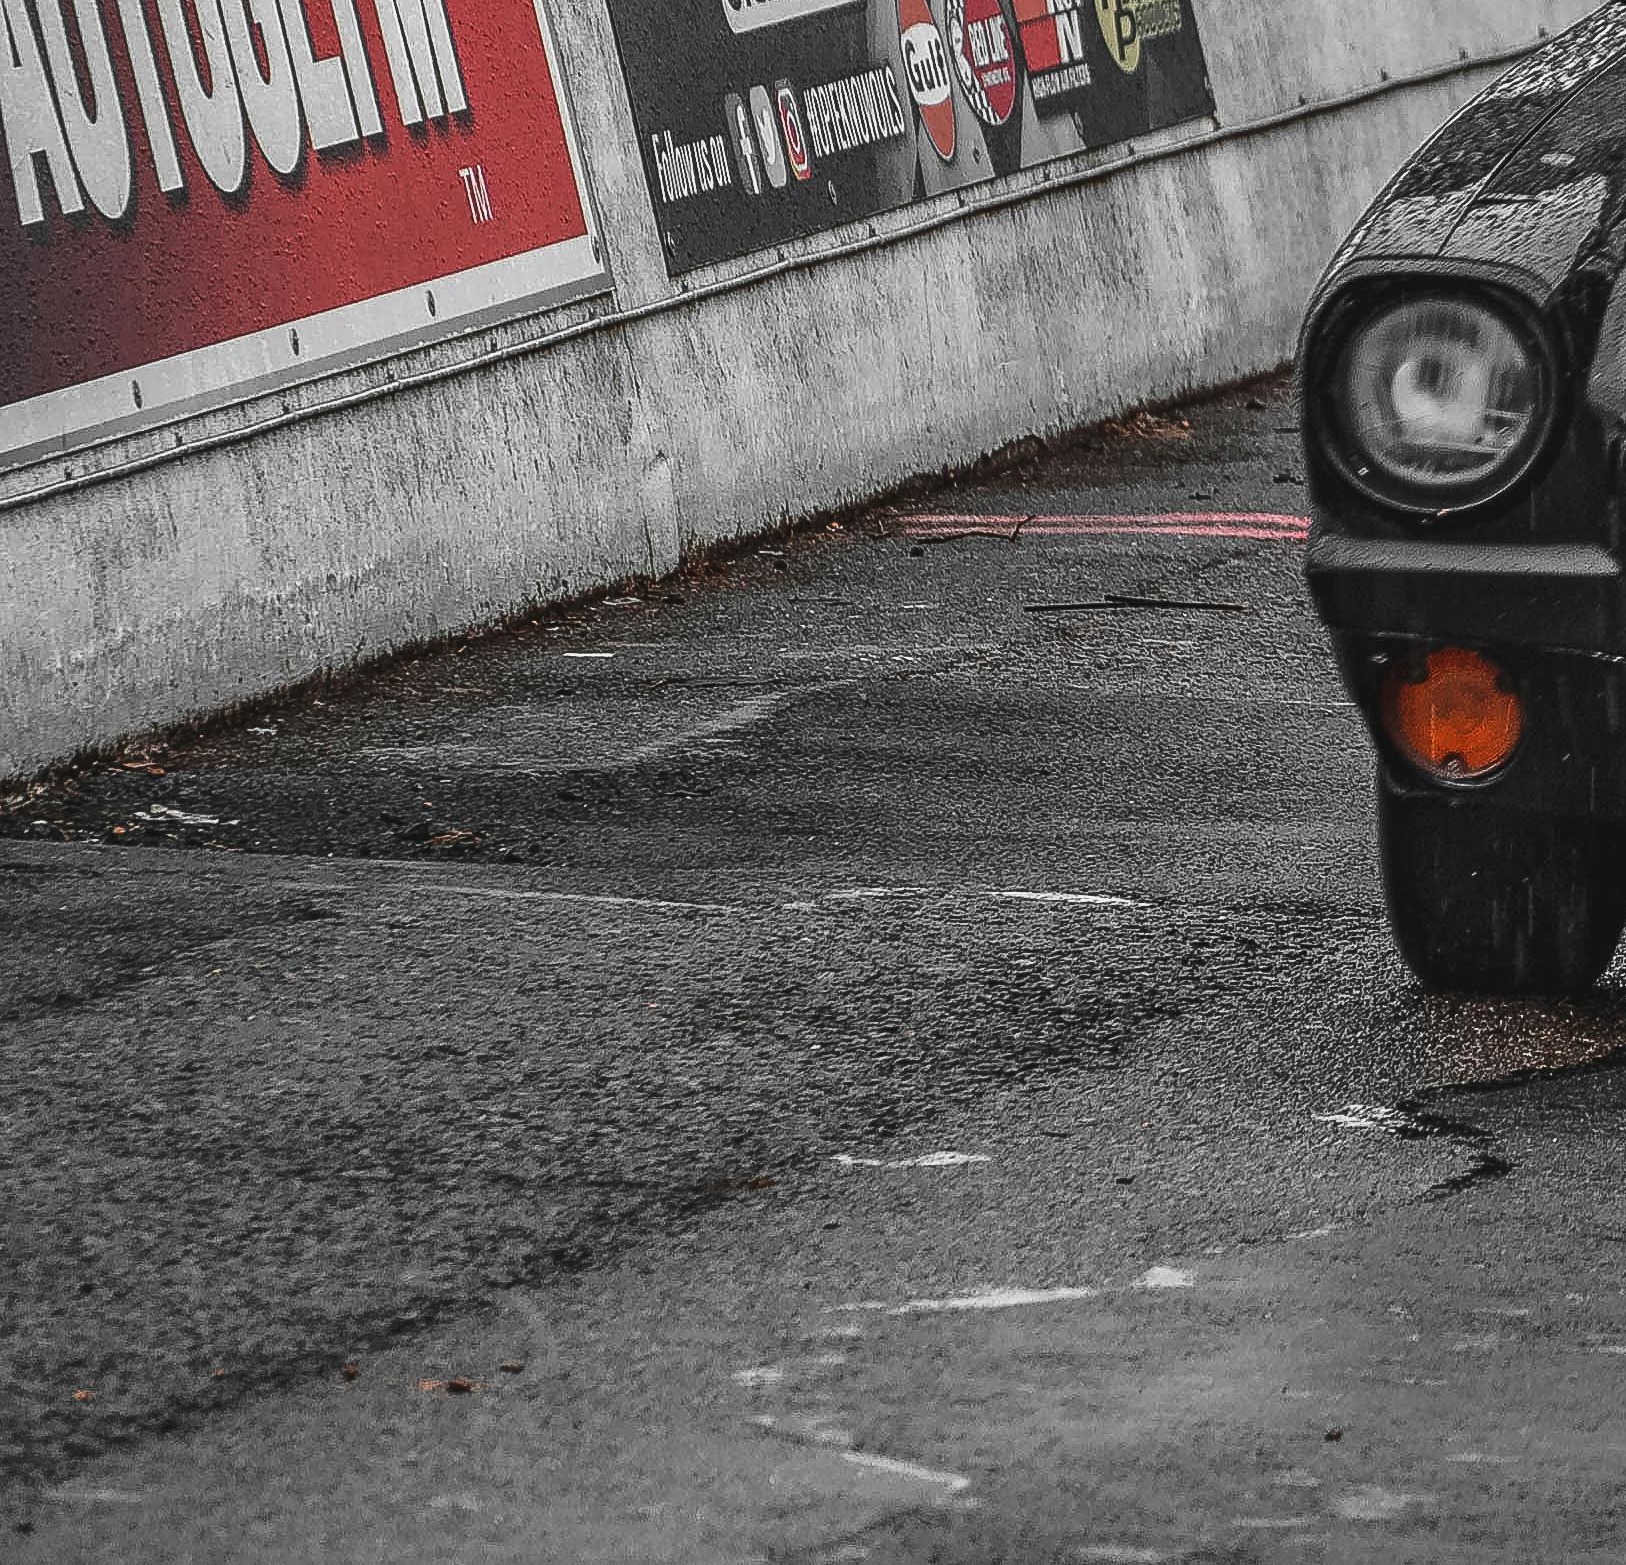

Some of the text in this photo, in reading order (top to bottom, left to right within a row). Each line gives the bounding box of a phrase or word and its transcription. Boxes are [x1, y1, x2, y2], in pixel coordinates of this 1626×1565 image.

[904, 35, 950, 94] Gulf
[803, 65, 905, 159] #OPIEKNOWOILS
[458, 165, 494, 226] TM
[652, 130, 698, 203] Follow
[693, 140, 715, 192] us
[709, 134, 732, 187] on
